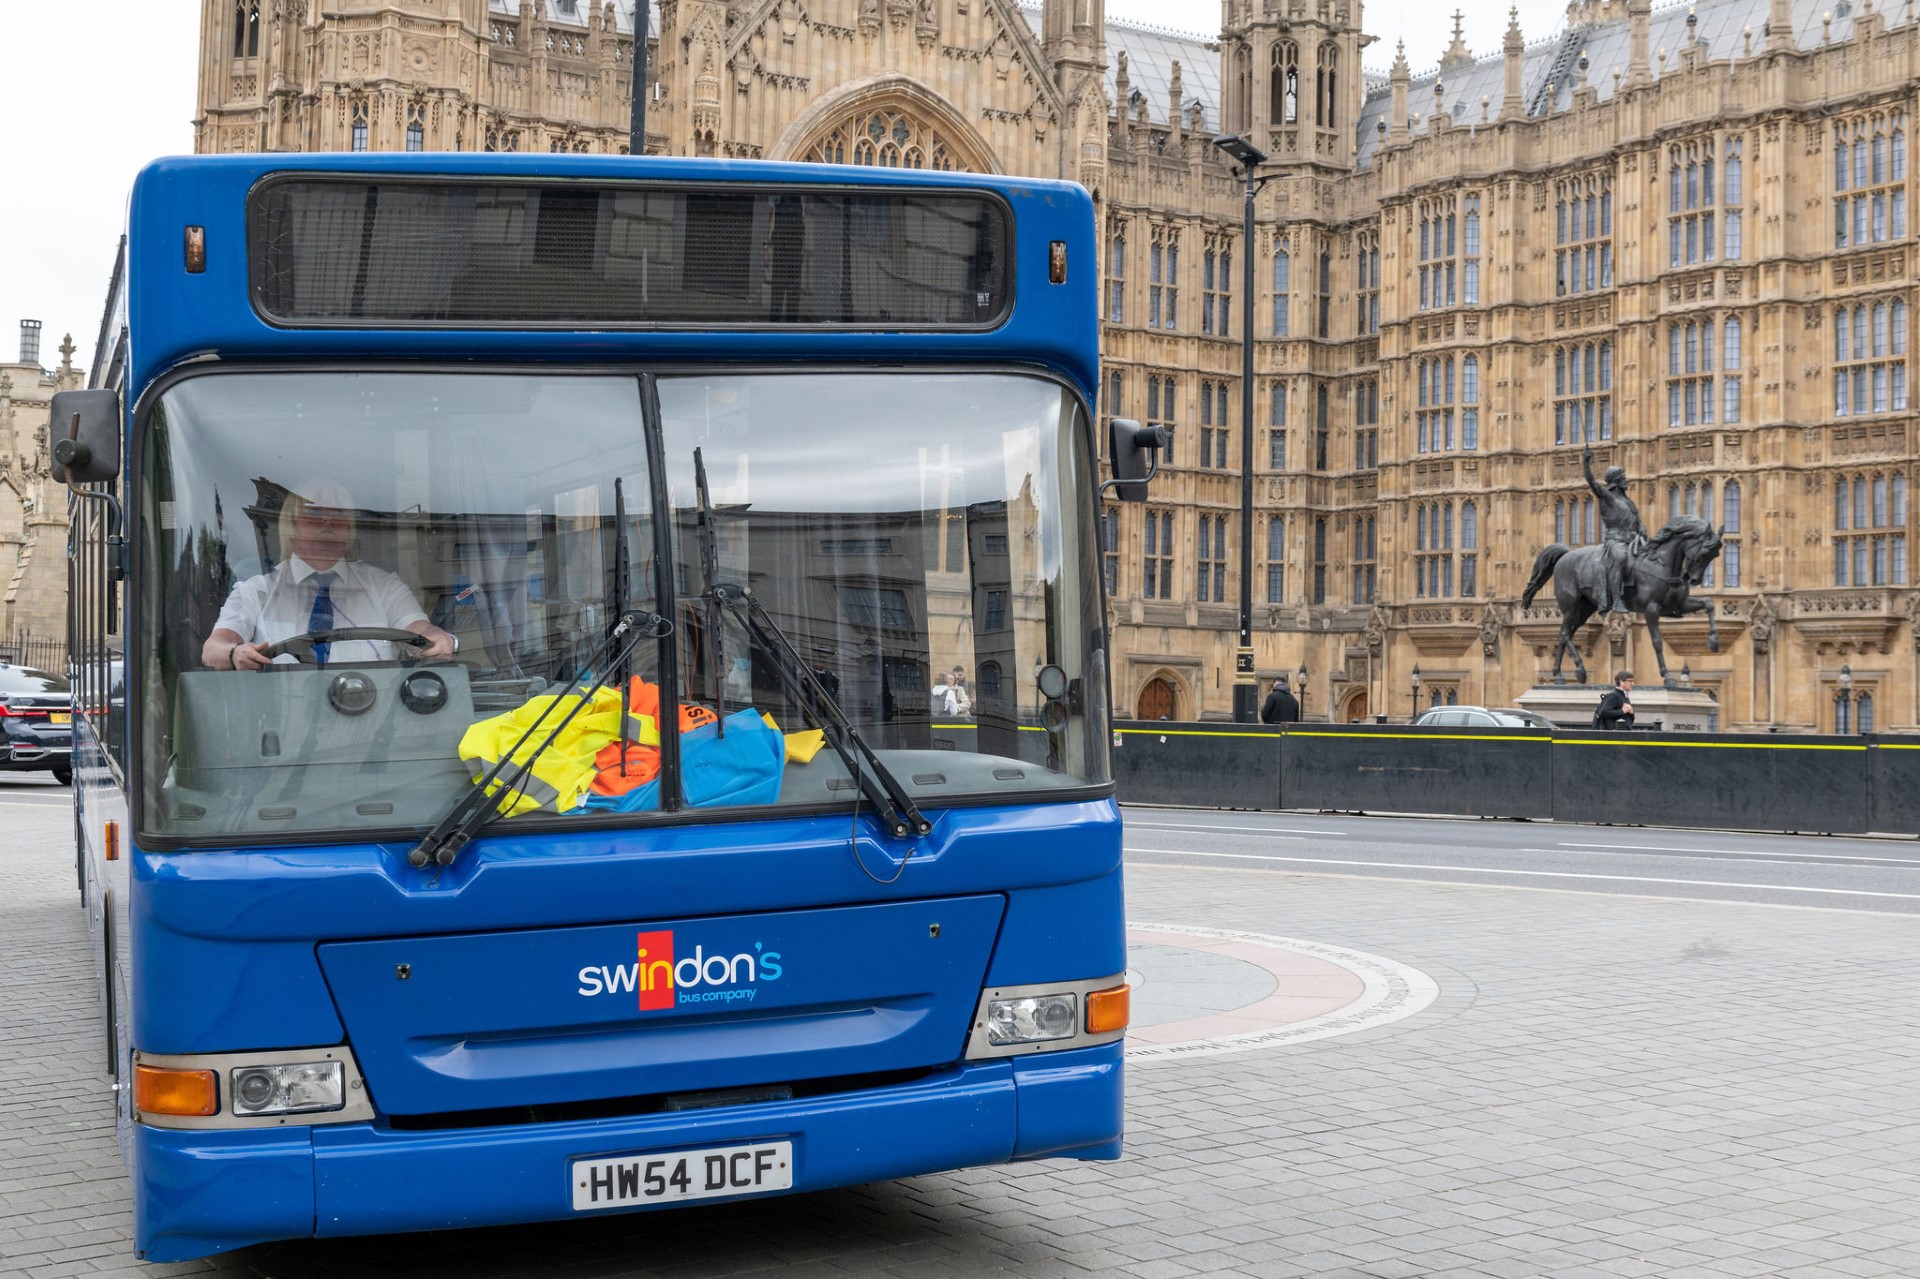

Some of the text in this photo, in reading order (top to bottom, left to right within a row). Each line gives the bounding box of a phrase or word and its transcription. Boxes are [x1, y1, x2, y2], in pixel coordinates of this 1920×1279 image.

[578, 942, 783, 997] swindon's
[679, 988, 757, 1004] bus company
[590, 1149, 776, 1202] HW54 DCF
